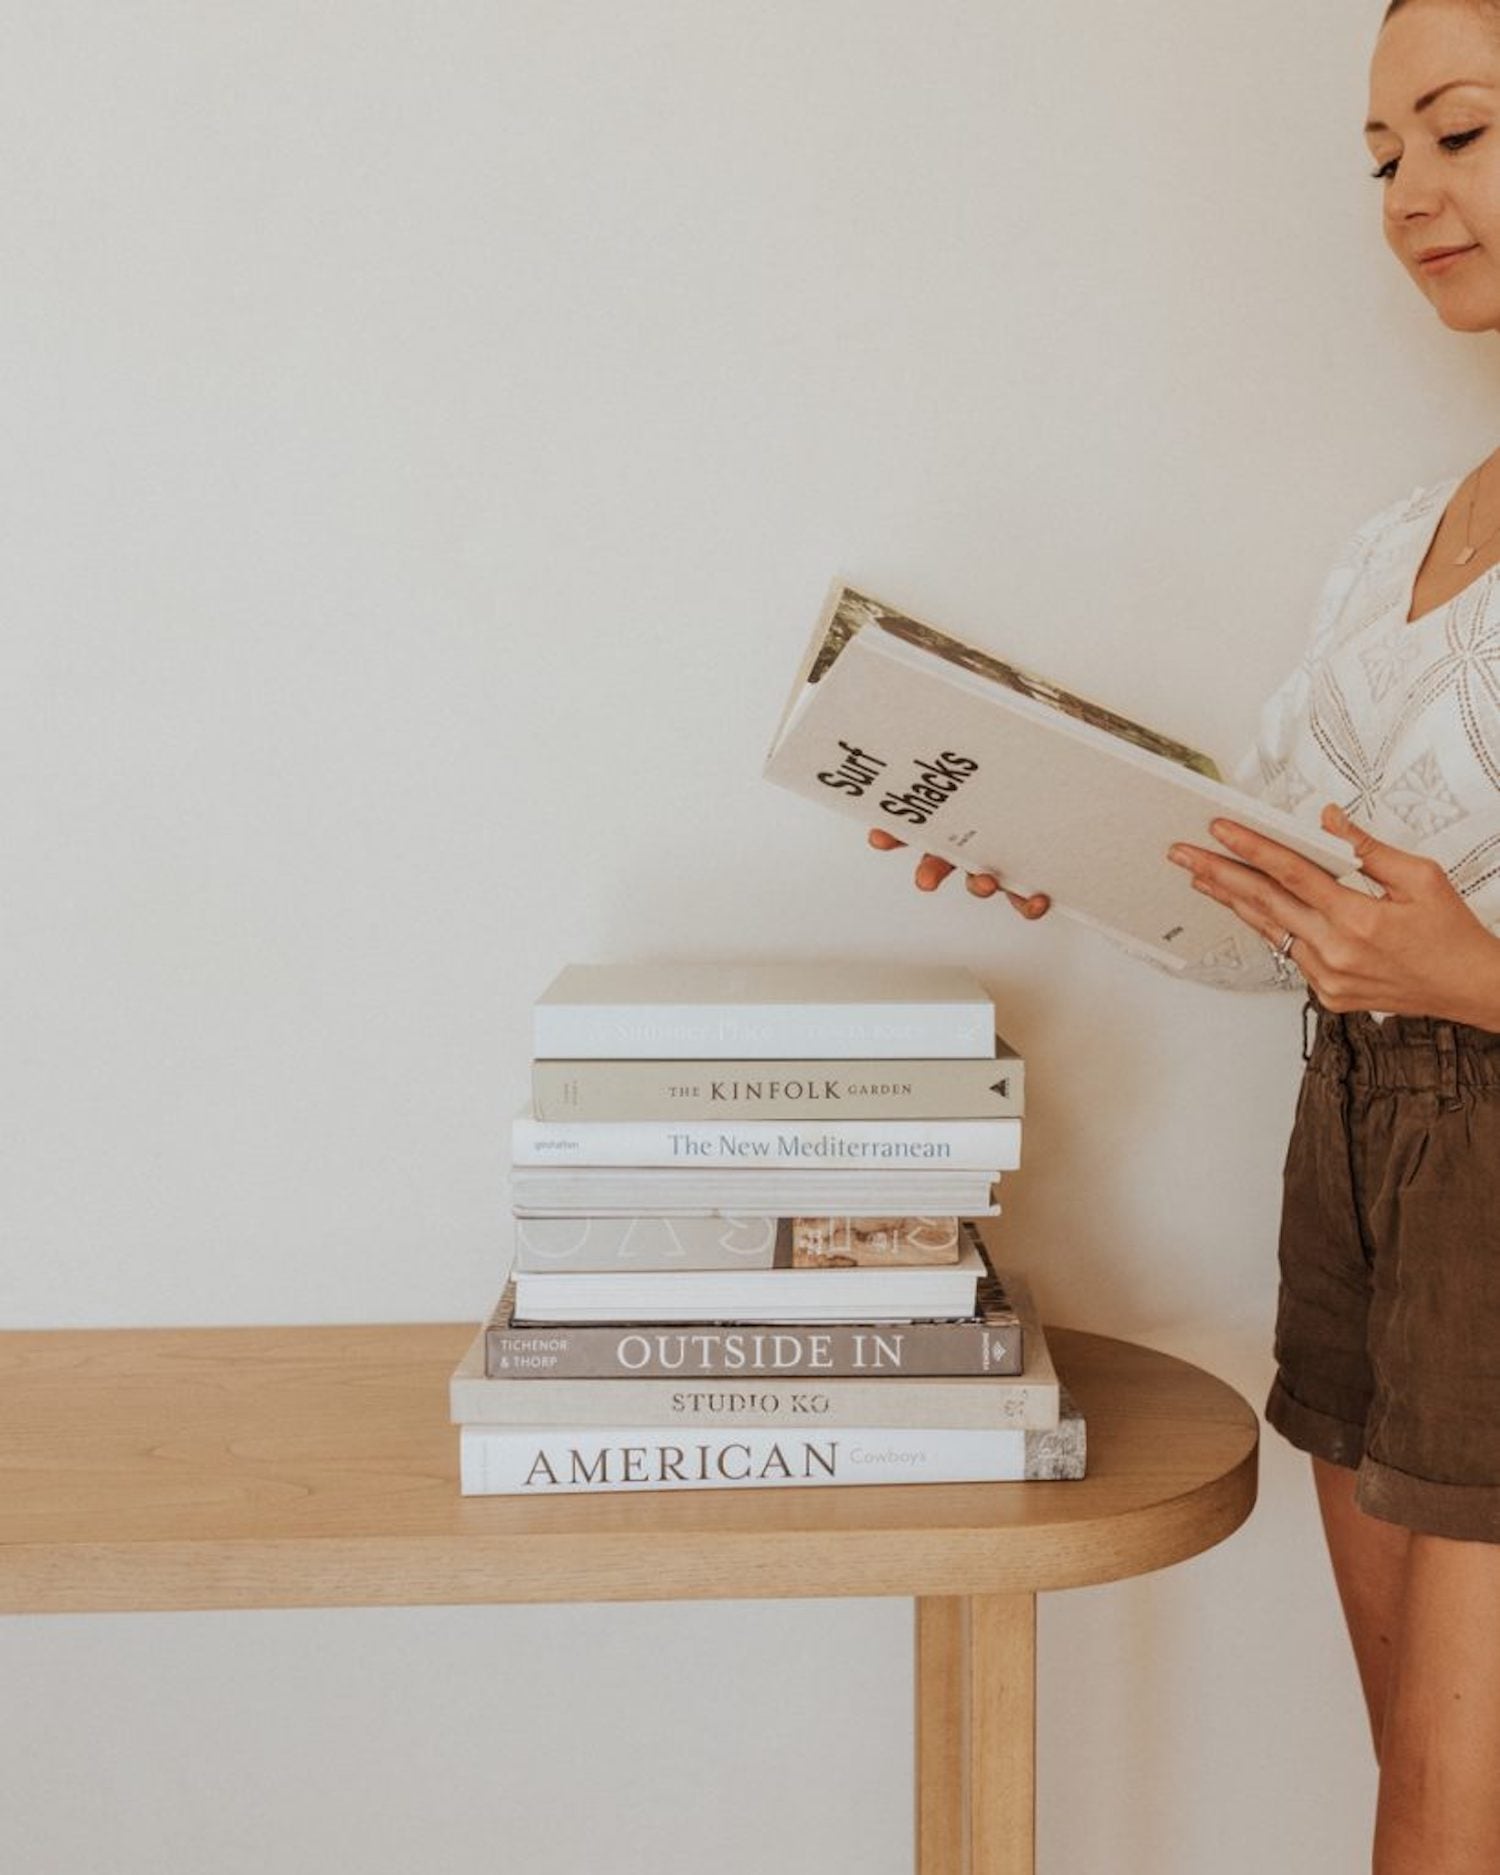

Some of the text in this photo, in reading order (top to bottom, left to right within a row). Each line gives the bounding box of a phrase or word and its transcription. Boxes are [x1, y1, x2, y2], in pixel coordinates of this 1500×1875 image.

[817, 741, 887, 797] Surf
[879, 751, 979, 824] Shacks
[669, 1080, 912, 1102] THE KINFOLK GARDEN
[668, 1134, 951, 1158] The New Mediterranean
[501, 1340, 568, 1353] TICHENOR
[617, 1334, 904, 1370] OUTSIDE IN
[514, 1356, 559, 1369] THORP
[671, 1392, 781, 1414] STUDIO
[525, 1443, 839, 1485] AMERICAN
[849, 1447, 928, 1468] Cowboys
